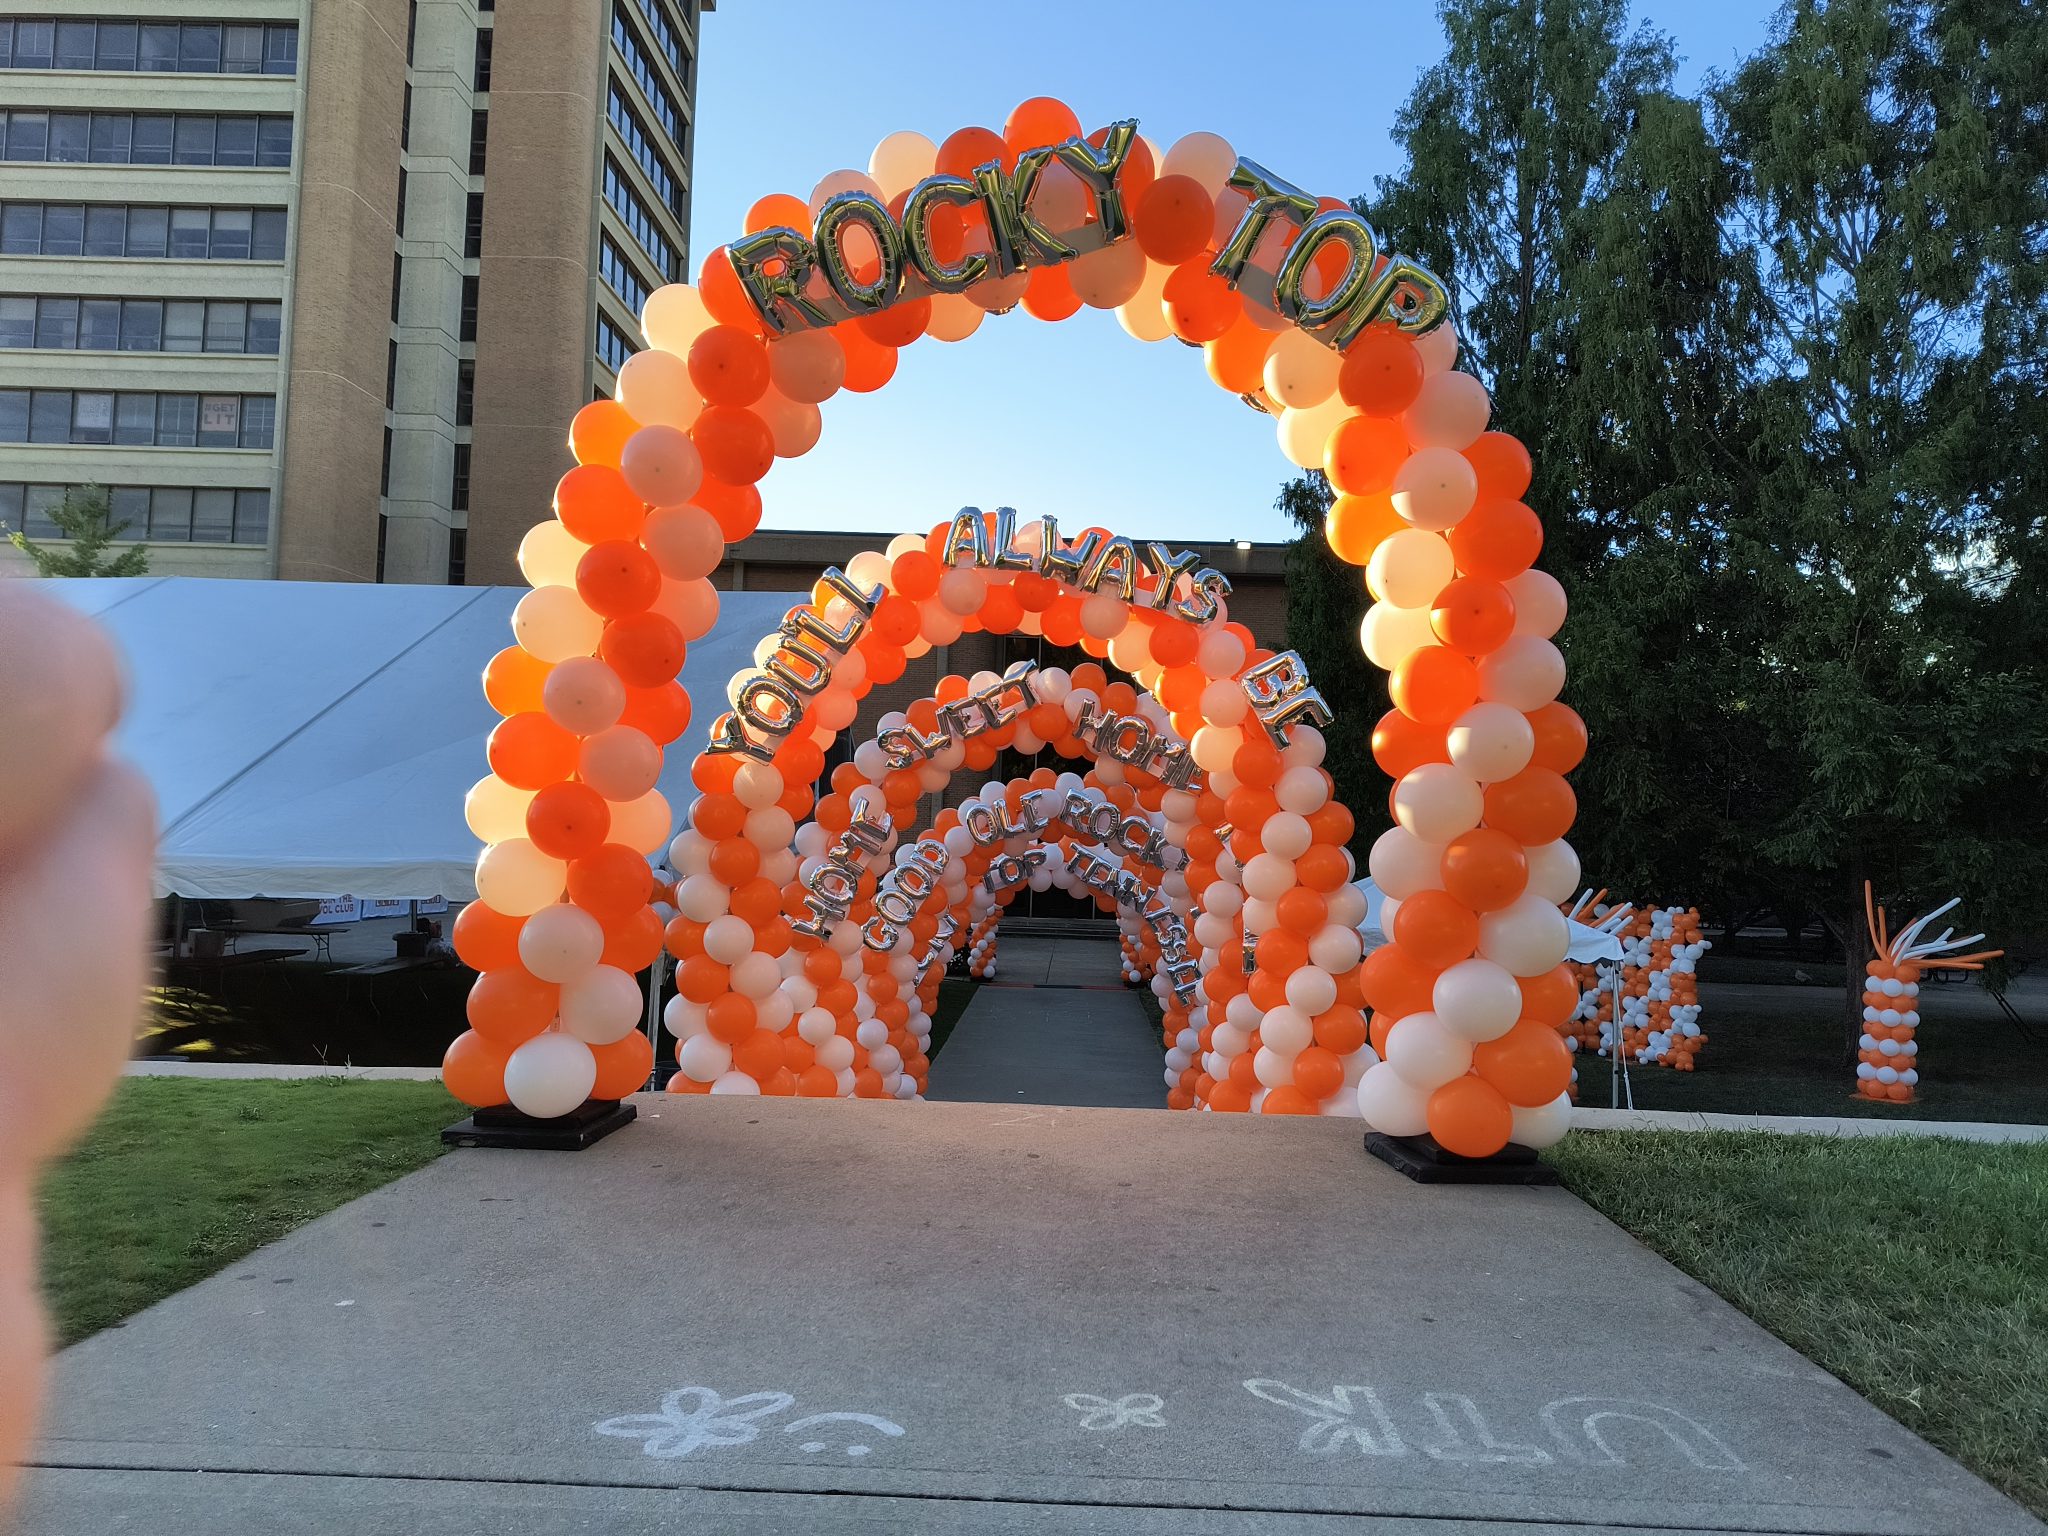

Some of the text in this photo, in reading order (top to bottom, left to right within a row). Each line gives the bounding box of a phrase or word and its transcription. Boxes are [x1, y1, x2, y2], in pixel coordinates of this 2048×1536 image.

[727, 118, 1452, 356] ROCKY TOP
[203, 414, 235, 425] LIT
[204, 402, 235, 412] #GET
[941, 505, 1235, 626] ALWAYS
[779, 796, 894, 941] HOME
[876, 658, 1038, 770] SWEET
[334, 903, 354, 914] CLUB
[860, 838, 950, 952] GOOD
[1242, 1378, 1750, 1472] UTK
